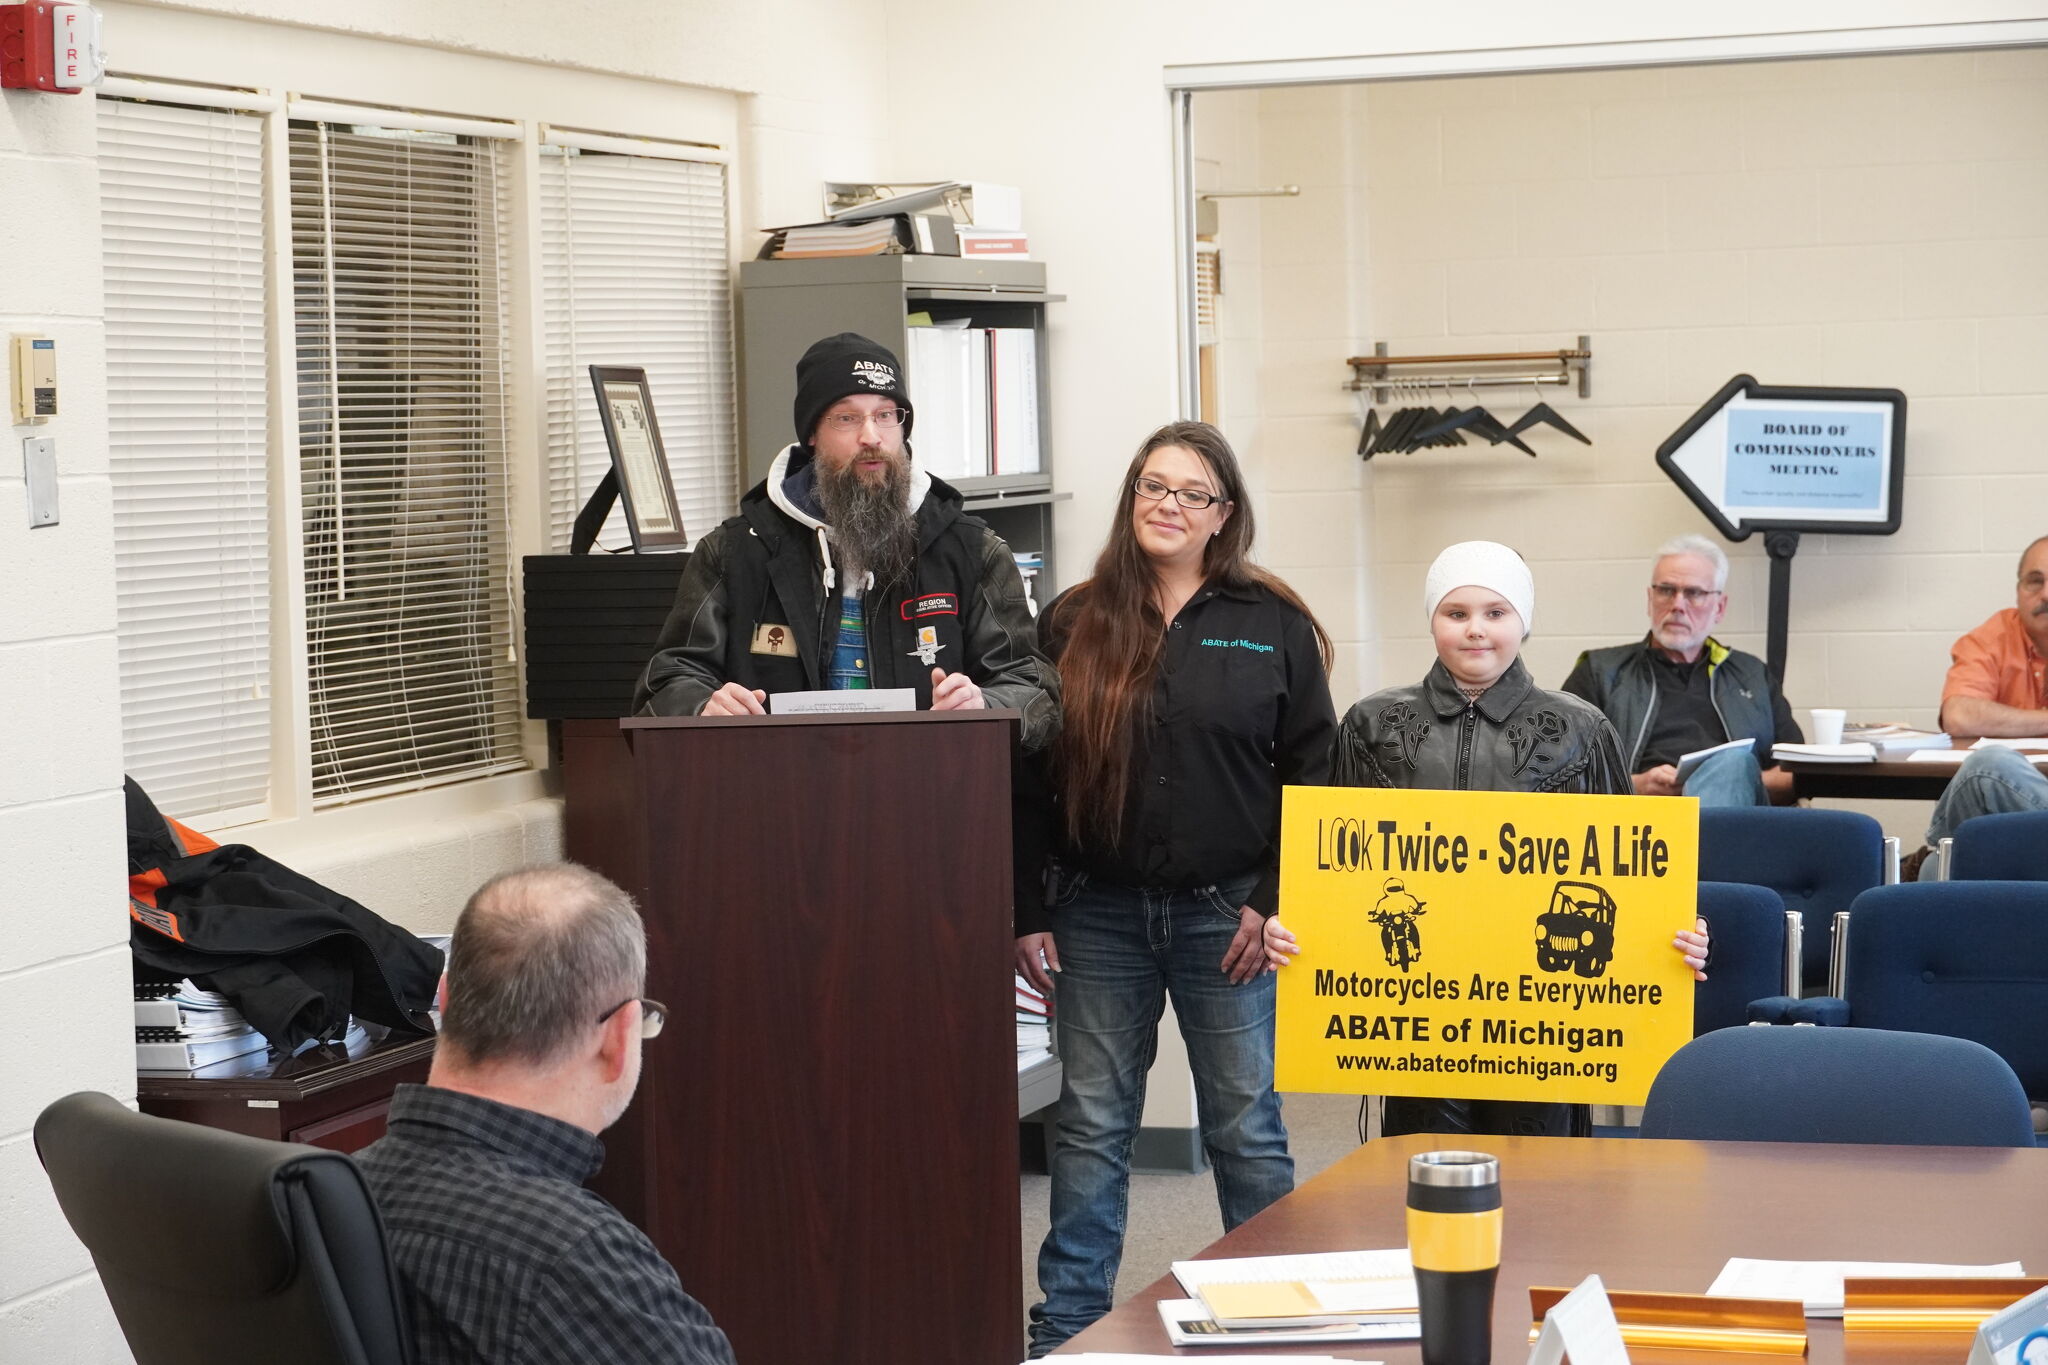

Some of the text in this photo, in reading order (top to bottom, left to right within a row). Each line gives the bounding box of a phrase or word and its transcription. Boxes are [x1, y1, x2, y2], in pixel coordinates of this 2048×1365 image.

[66, 14, 78, 77] FIRE
[854, 360, 894, 377] ABATE
[1763, 423, 1849, 436] BOARD OF
[1734, 443, 1876, 458] COMMISSIONERS
[1769, 464, 1839, 475] MEETING
[918, 598, 946, 607] REGION
[1201, 638, 1274, 652] ABATE of Michigan
[1377, 820, 1469, 874] Twice
[1498, 822, 1570, 876] Save
[1579, 824, 1602, 876] A
[1612, 824, 1669, 878] Life
[1315, 968, 1663, 1011] Motorcycles Are Everywhere
[1324, 1014, 1624, 1054] ABATE of Michigan
[1336, 1052, 1618, 1083] www.abateofmichigan.org
